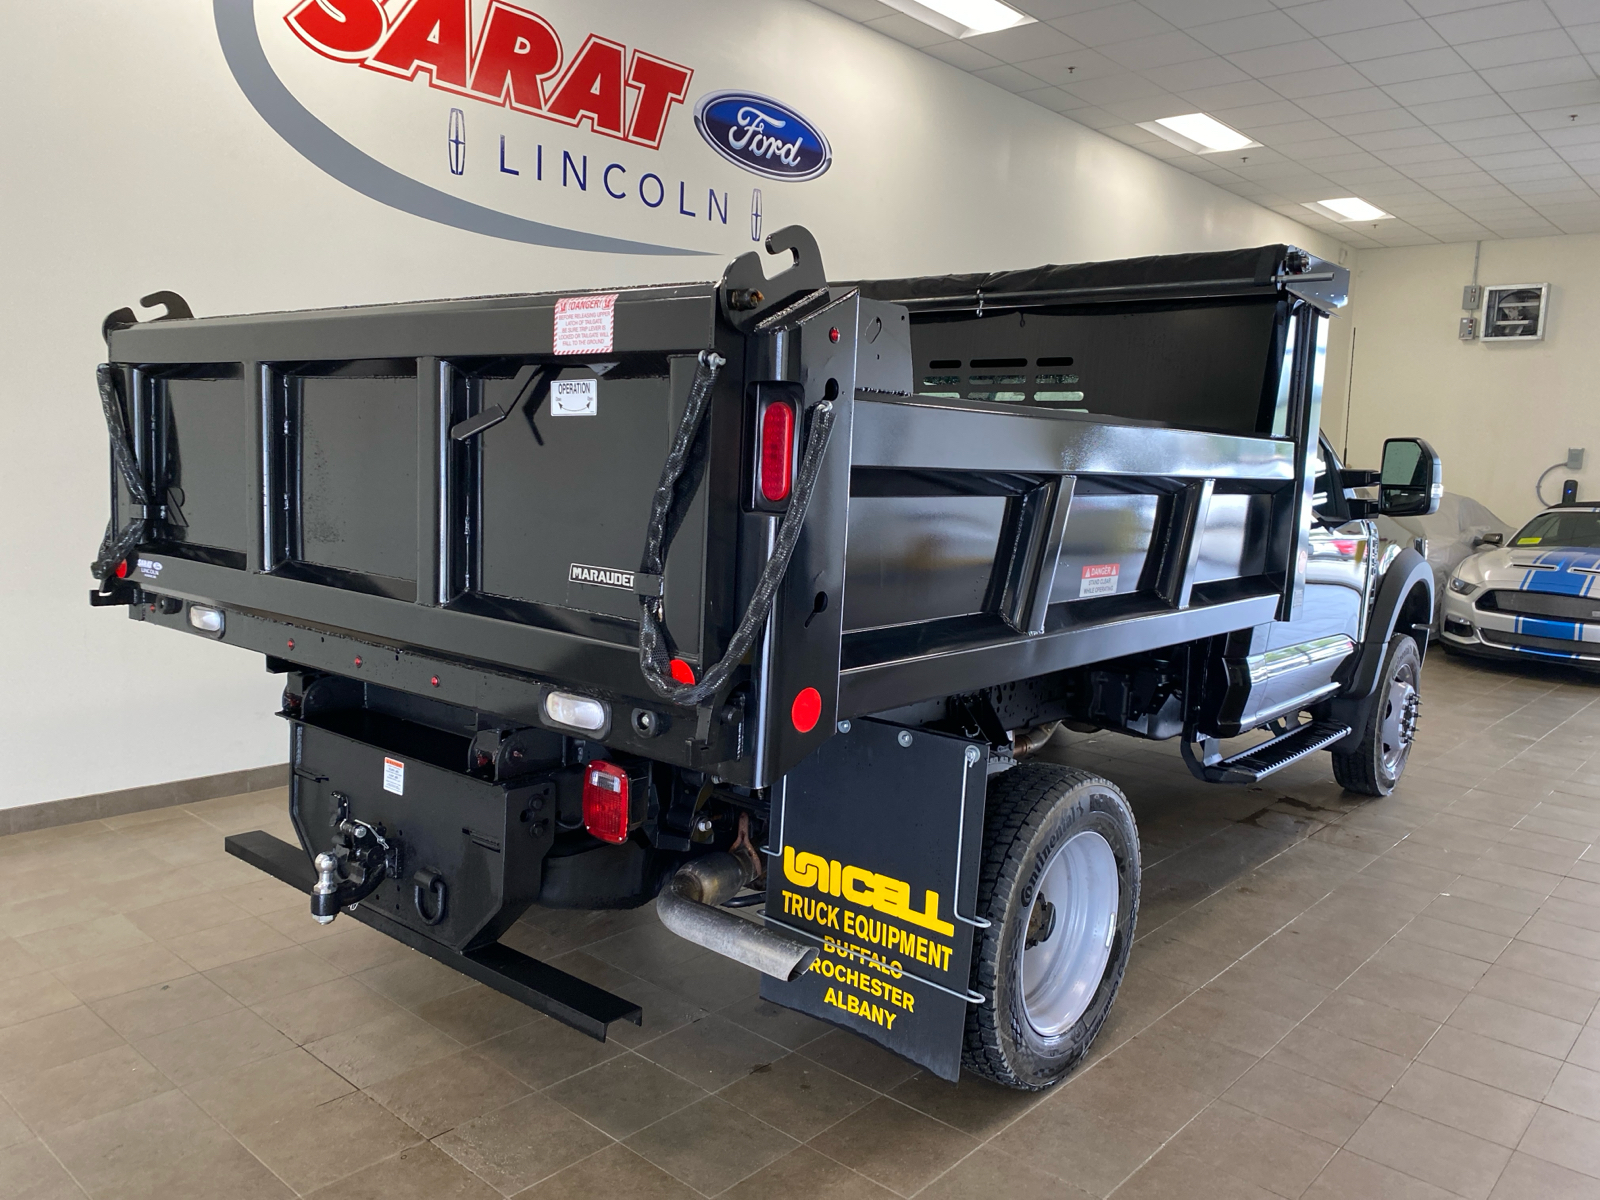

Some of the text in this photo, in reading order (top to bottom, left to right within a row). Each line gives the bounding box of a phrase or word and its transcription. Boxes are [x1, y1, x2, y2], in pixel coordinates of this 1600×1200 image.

[728, 106, 803, 167] Ford
[500, 134, 729, 225] LINCOLN
[558, 382, 591, 395] OPERATION
[1083, 585, 1114, 594] WHILE OPERATING
[1088, 577, 1112, 586] STAND CLEAR
[1091, 565, 1112, 576] DANGER
[1020, 806, 1077, 907] Continental
[781, 890, 953, 972] TRUCK EQUIPMENT
[823, 935, 903, 980] BUFFALO
[808, 957, 915, 1013] ROCHESTER
[823, 987, 897, 1030] ALBANY
